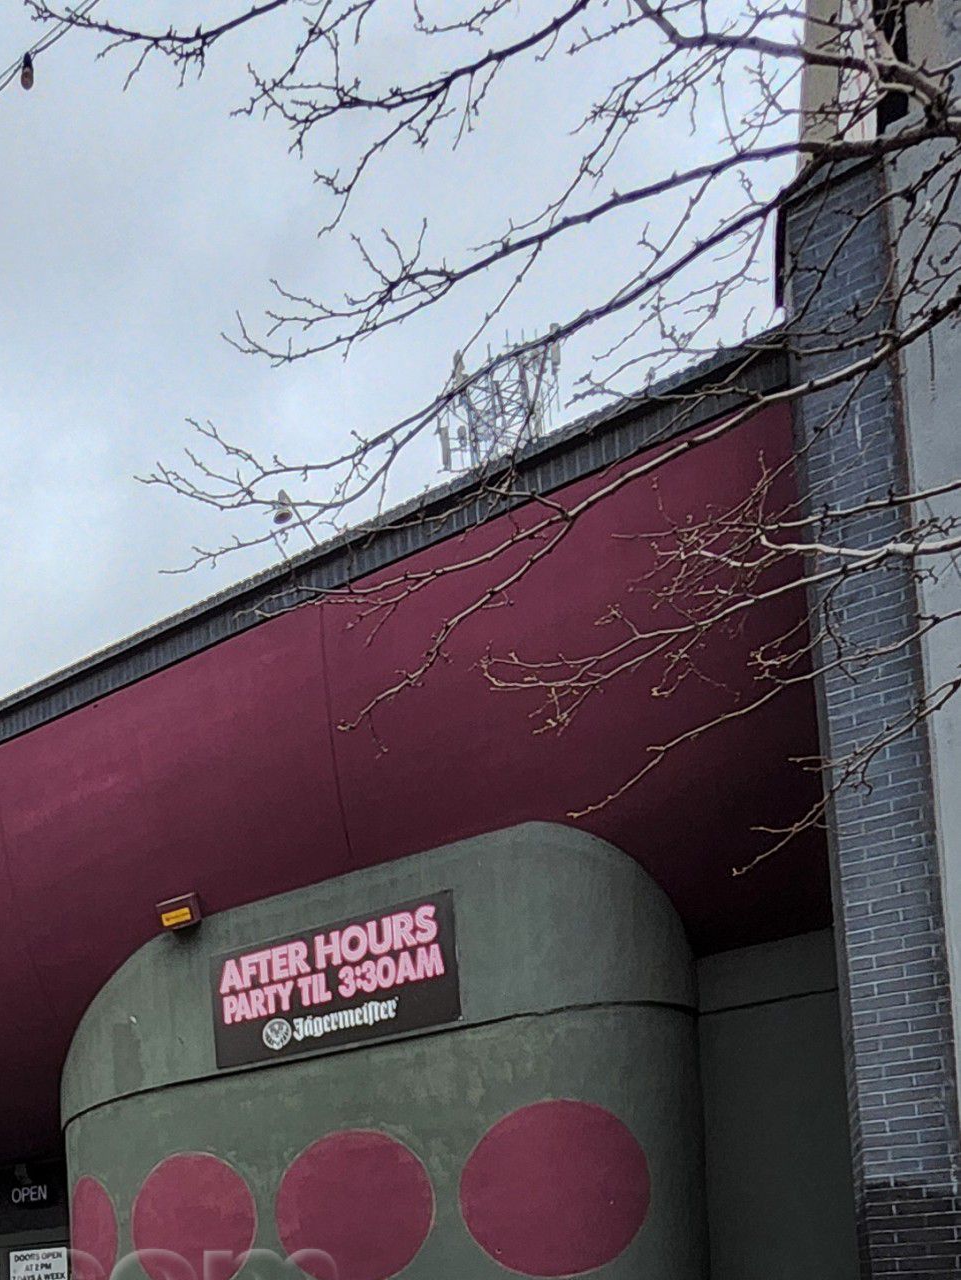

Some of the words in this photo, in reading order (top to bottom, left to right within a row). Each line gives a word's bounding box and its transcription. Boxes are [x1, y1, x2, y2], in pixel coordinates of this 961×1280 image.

[220, 941, 311, 994] AFTER
[314, 905, 437, 969] HOURS
[223, 981, 294, 1024] PARTY
[298, 973, 332, 1006] TIL
[338, 944, 445, 998] 3:30AM
[11, 1185, 47, 1203] OPEN
[14, 1253, 40, 1263] DOORS
[41, 1251, 63, 1260] OPEN
[24, 1264, 33, 1272] AT
[37, 1273, 43, 1280] A
[44, 1271, 66, 1280] WEEK
